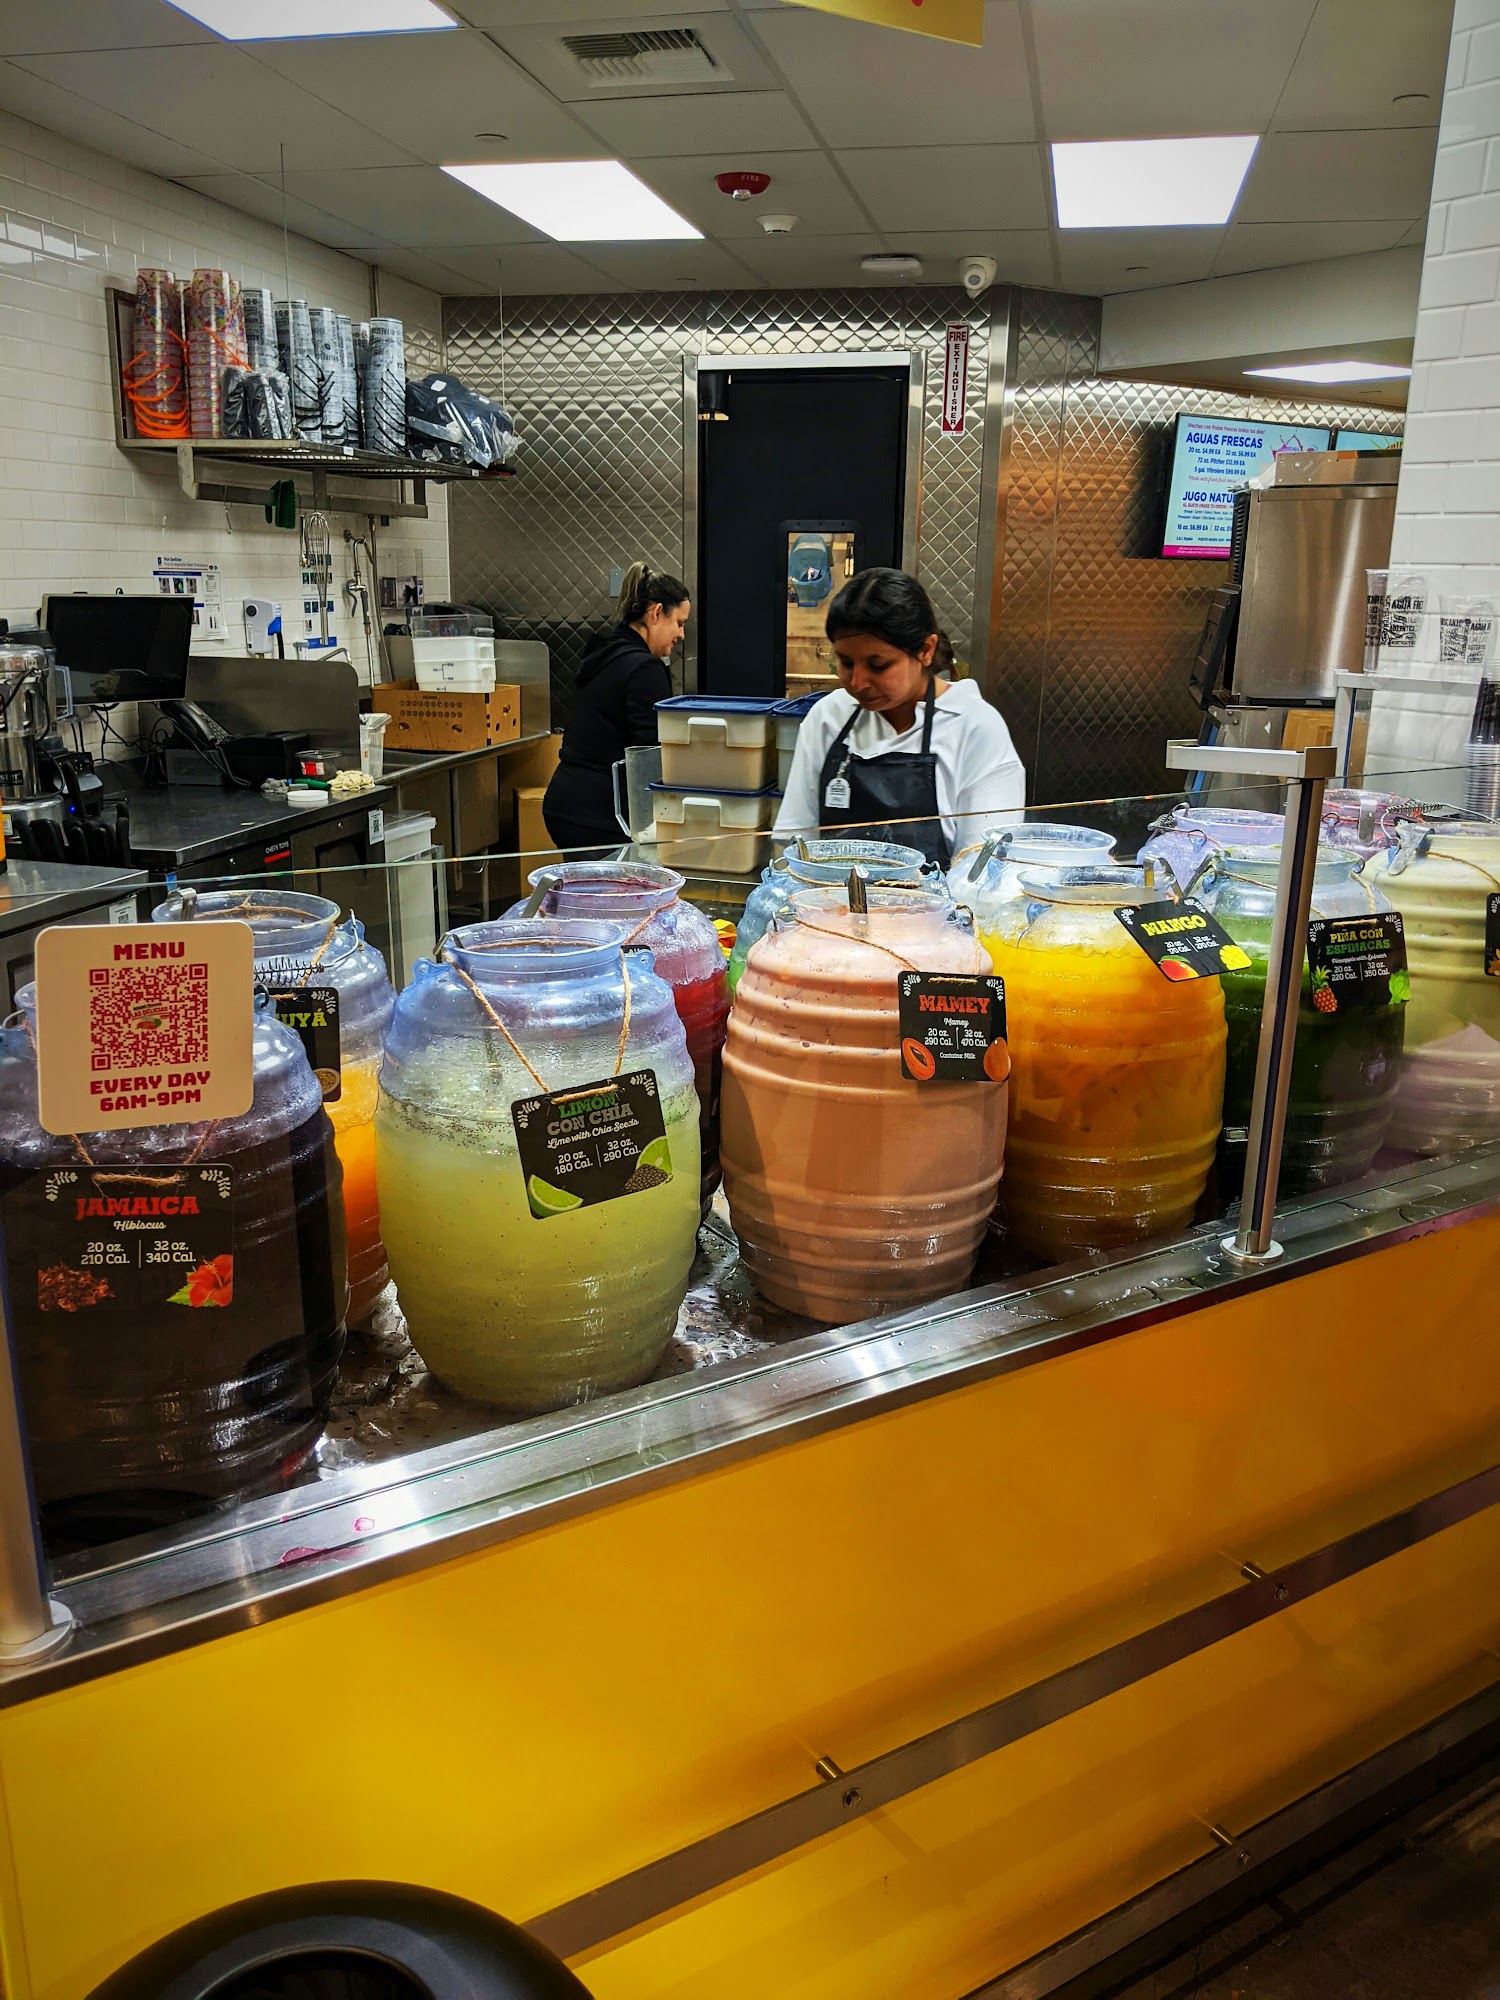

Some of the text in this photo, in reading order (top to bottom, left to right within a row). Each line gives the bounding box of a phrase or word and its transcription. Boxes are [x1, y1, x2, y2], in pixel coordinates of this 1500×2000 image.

[949, 332, 966, 342] FIRE
[950, 344, 960, 425] EXTINGUISHER
[1186, 432, 1263, 449] AGUAS FRESCAS
[1183, 491, 1234, 503] JUGO NATU
[1140, 914, 1206, 937] MANGO
[1330, 928, 1383, 944] PIÑA CON
[114, 942, 184, 960] MENU
[1196, 942, 1207, 950] 270
[1326, 939, 1390, 955] ESPINACAS
[1331, 956, 1356, 964] Pineapple
[1344, 972, 1358, 980] Cal.
[1364, 970, 1376, 978] 350
[919, 994, 990, 1014] MAMEY
[275, 1008, 328, 1028] UYÁ
[944, 1018, 969, 1028] Mamey
[928, 1028, 938, 1036] 20
[924, 1037, 953, 1046] 290 Cal.
[961, 1038, 988, 1047] 470 Cal.
[964, 1052, 976, 1060] Milk
[90, 1070, 210, 1095] EVERY DAY
[100, 1089, 201, 1112] 6AM-9PM
[558, 1092, 616, 1118] LIMÓN
[547, 1102, 634, 1136] CON CHÍA
[547, 1118, 639, 1149] Lime with Chia Seeds
[606, 1138, 634, 1151] 32 oz.
[558, 1150, 586, 1164] 20 oz.
[603, 1146, 641, 1162] 290 Cal.
[554, 1158, 593, 1175] 180 Cal.
[75, 1196, 200, 1221] JAMAICA
[113, 1219, 166, 1231] Hibiscus
[87, 1242, 124, 1252] 20 oz.
[154, 1240, 189, 1250] 32 oz.
[81, 1253, 130, 1264] 210 Cal.
[146, 1252, 196, 1263] 340 Cal.
